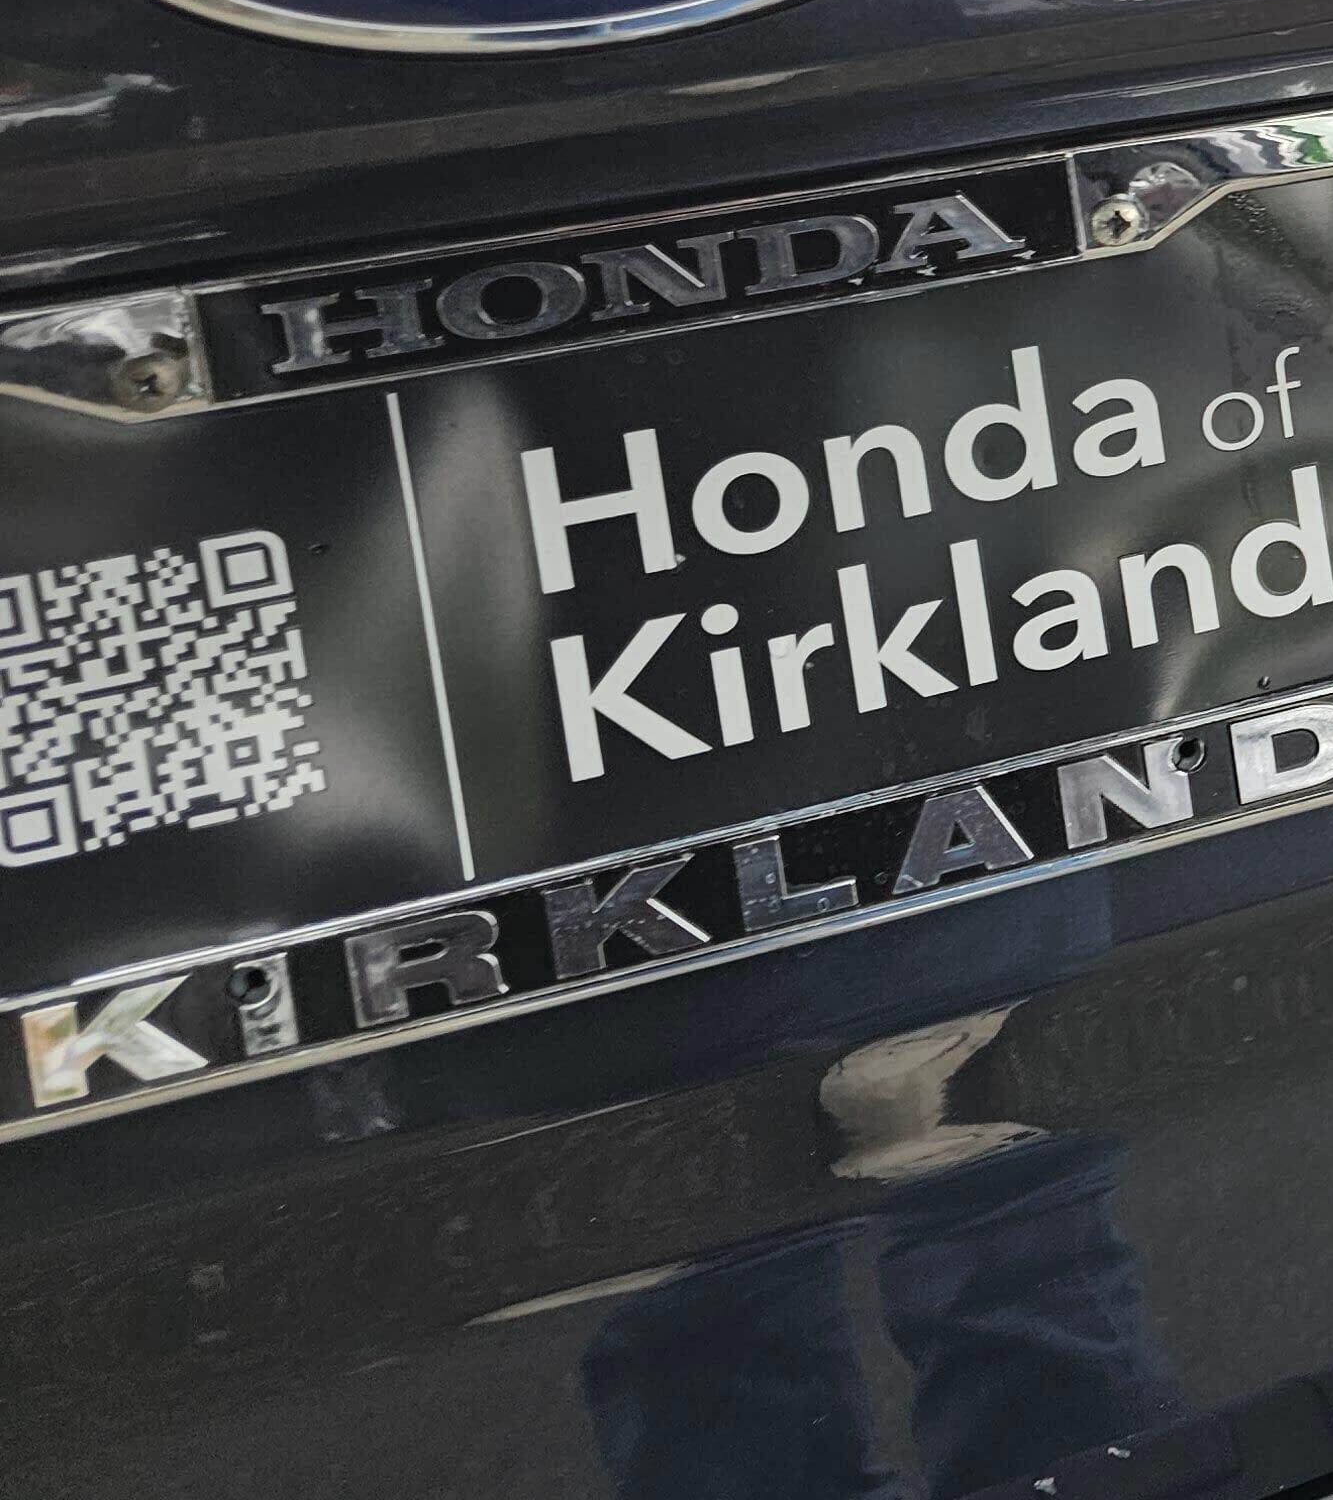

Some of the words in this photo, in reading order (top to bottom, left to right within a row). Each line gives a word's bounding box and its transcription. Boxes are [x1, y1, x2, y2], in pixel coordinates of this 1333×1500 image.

[261, 190, 1027, 374] HONDA
[523, 346, 1166, 594] Honda
[1201, 346, 1302, 454] of
